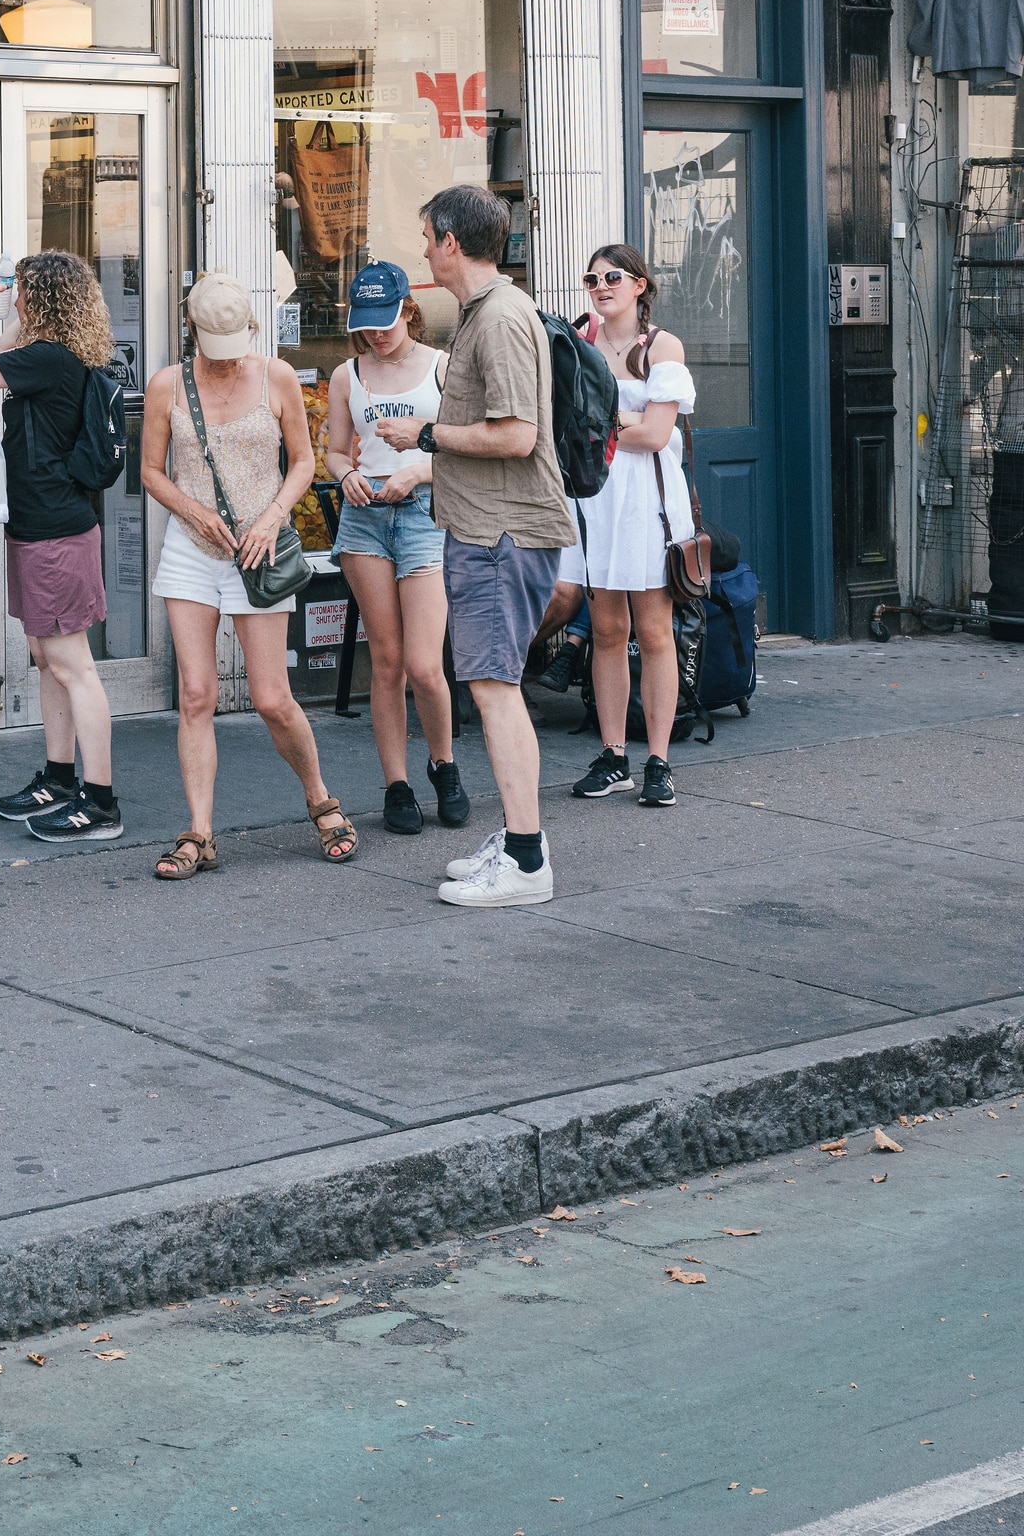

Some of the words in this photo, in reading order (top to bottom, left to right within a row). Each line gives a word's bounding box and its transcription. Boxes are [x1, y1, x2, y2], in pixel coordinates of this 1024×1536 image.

[672, 7, 689, 16] VIDEO
[667, 18, 710, 28] SURVEILLANCE
[339, 86, 399, 105] CANDIES
[29, 114, 90, 129] HALAVAH
[326, 180, 361, 195] DAUGHTERS
[327, 200, 342, 212] LAKE
[363, 402, 415, 424] GREENWICH
[308, 604, 339, 616] AUTOMATIC
[315, 615, 331, 625] SHUT
[331, 613, 343, 624] OFF
[311, 633, 339, 645] OPPOSITE
[685, 640, 698, 687] OSPREY
[32, 788, 54, 805] N
[68, 811, 91, 828] N
